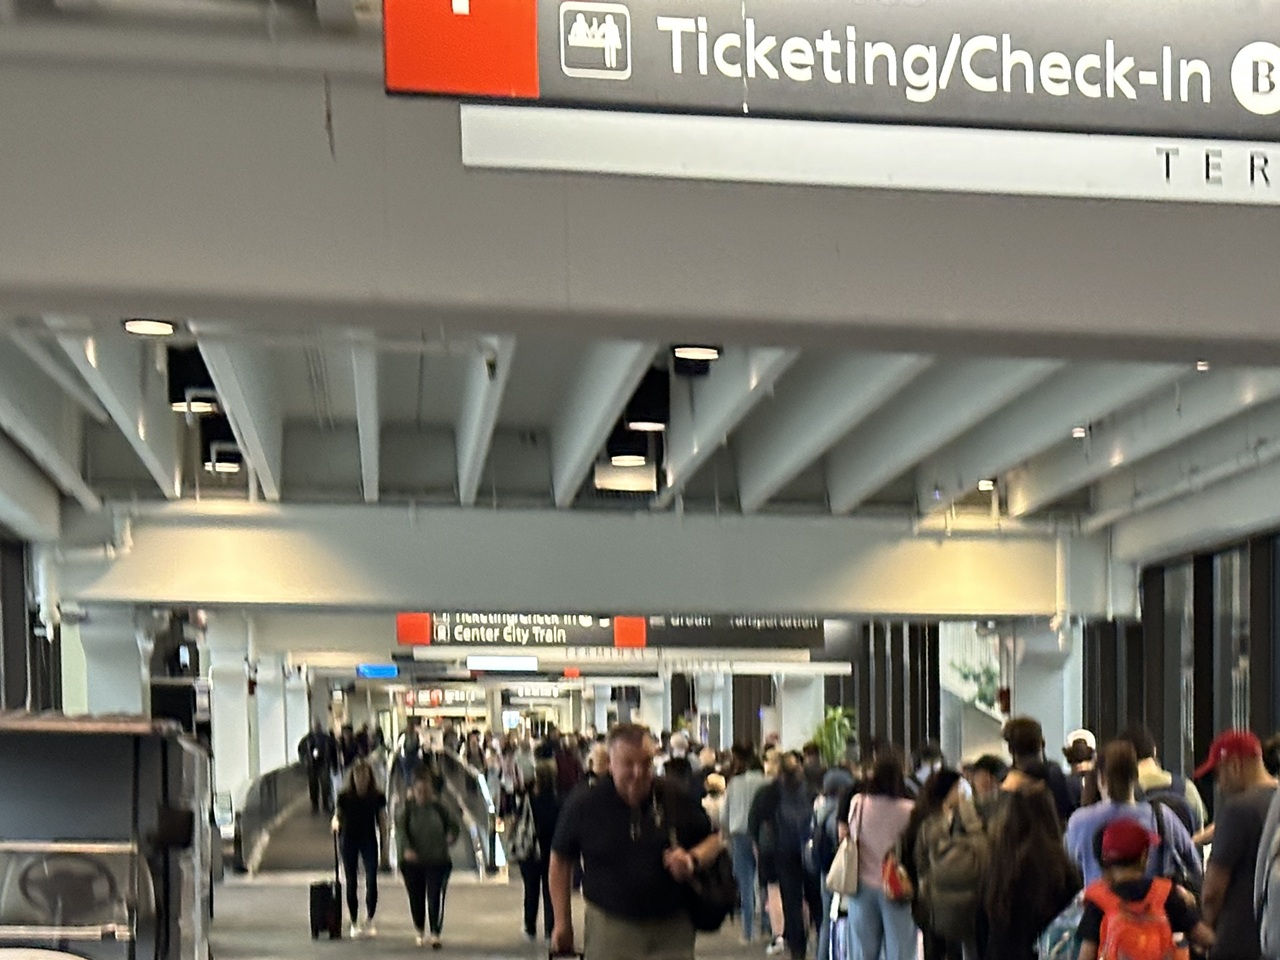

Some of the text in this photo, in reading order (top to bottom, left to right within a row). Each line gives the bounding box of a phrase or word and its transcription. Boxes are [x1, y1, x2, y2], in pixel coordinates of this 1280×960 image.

[657, 16, 1211, 103] Ticketing/Check-In
[454, 624, 567, 646] Center City Train
